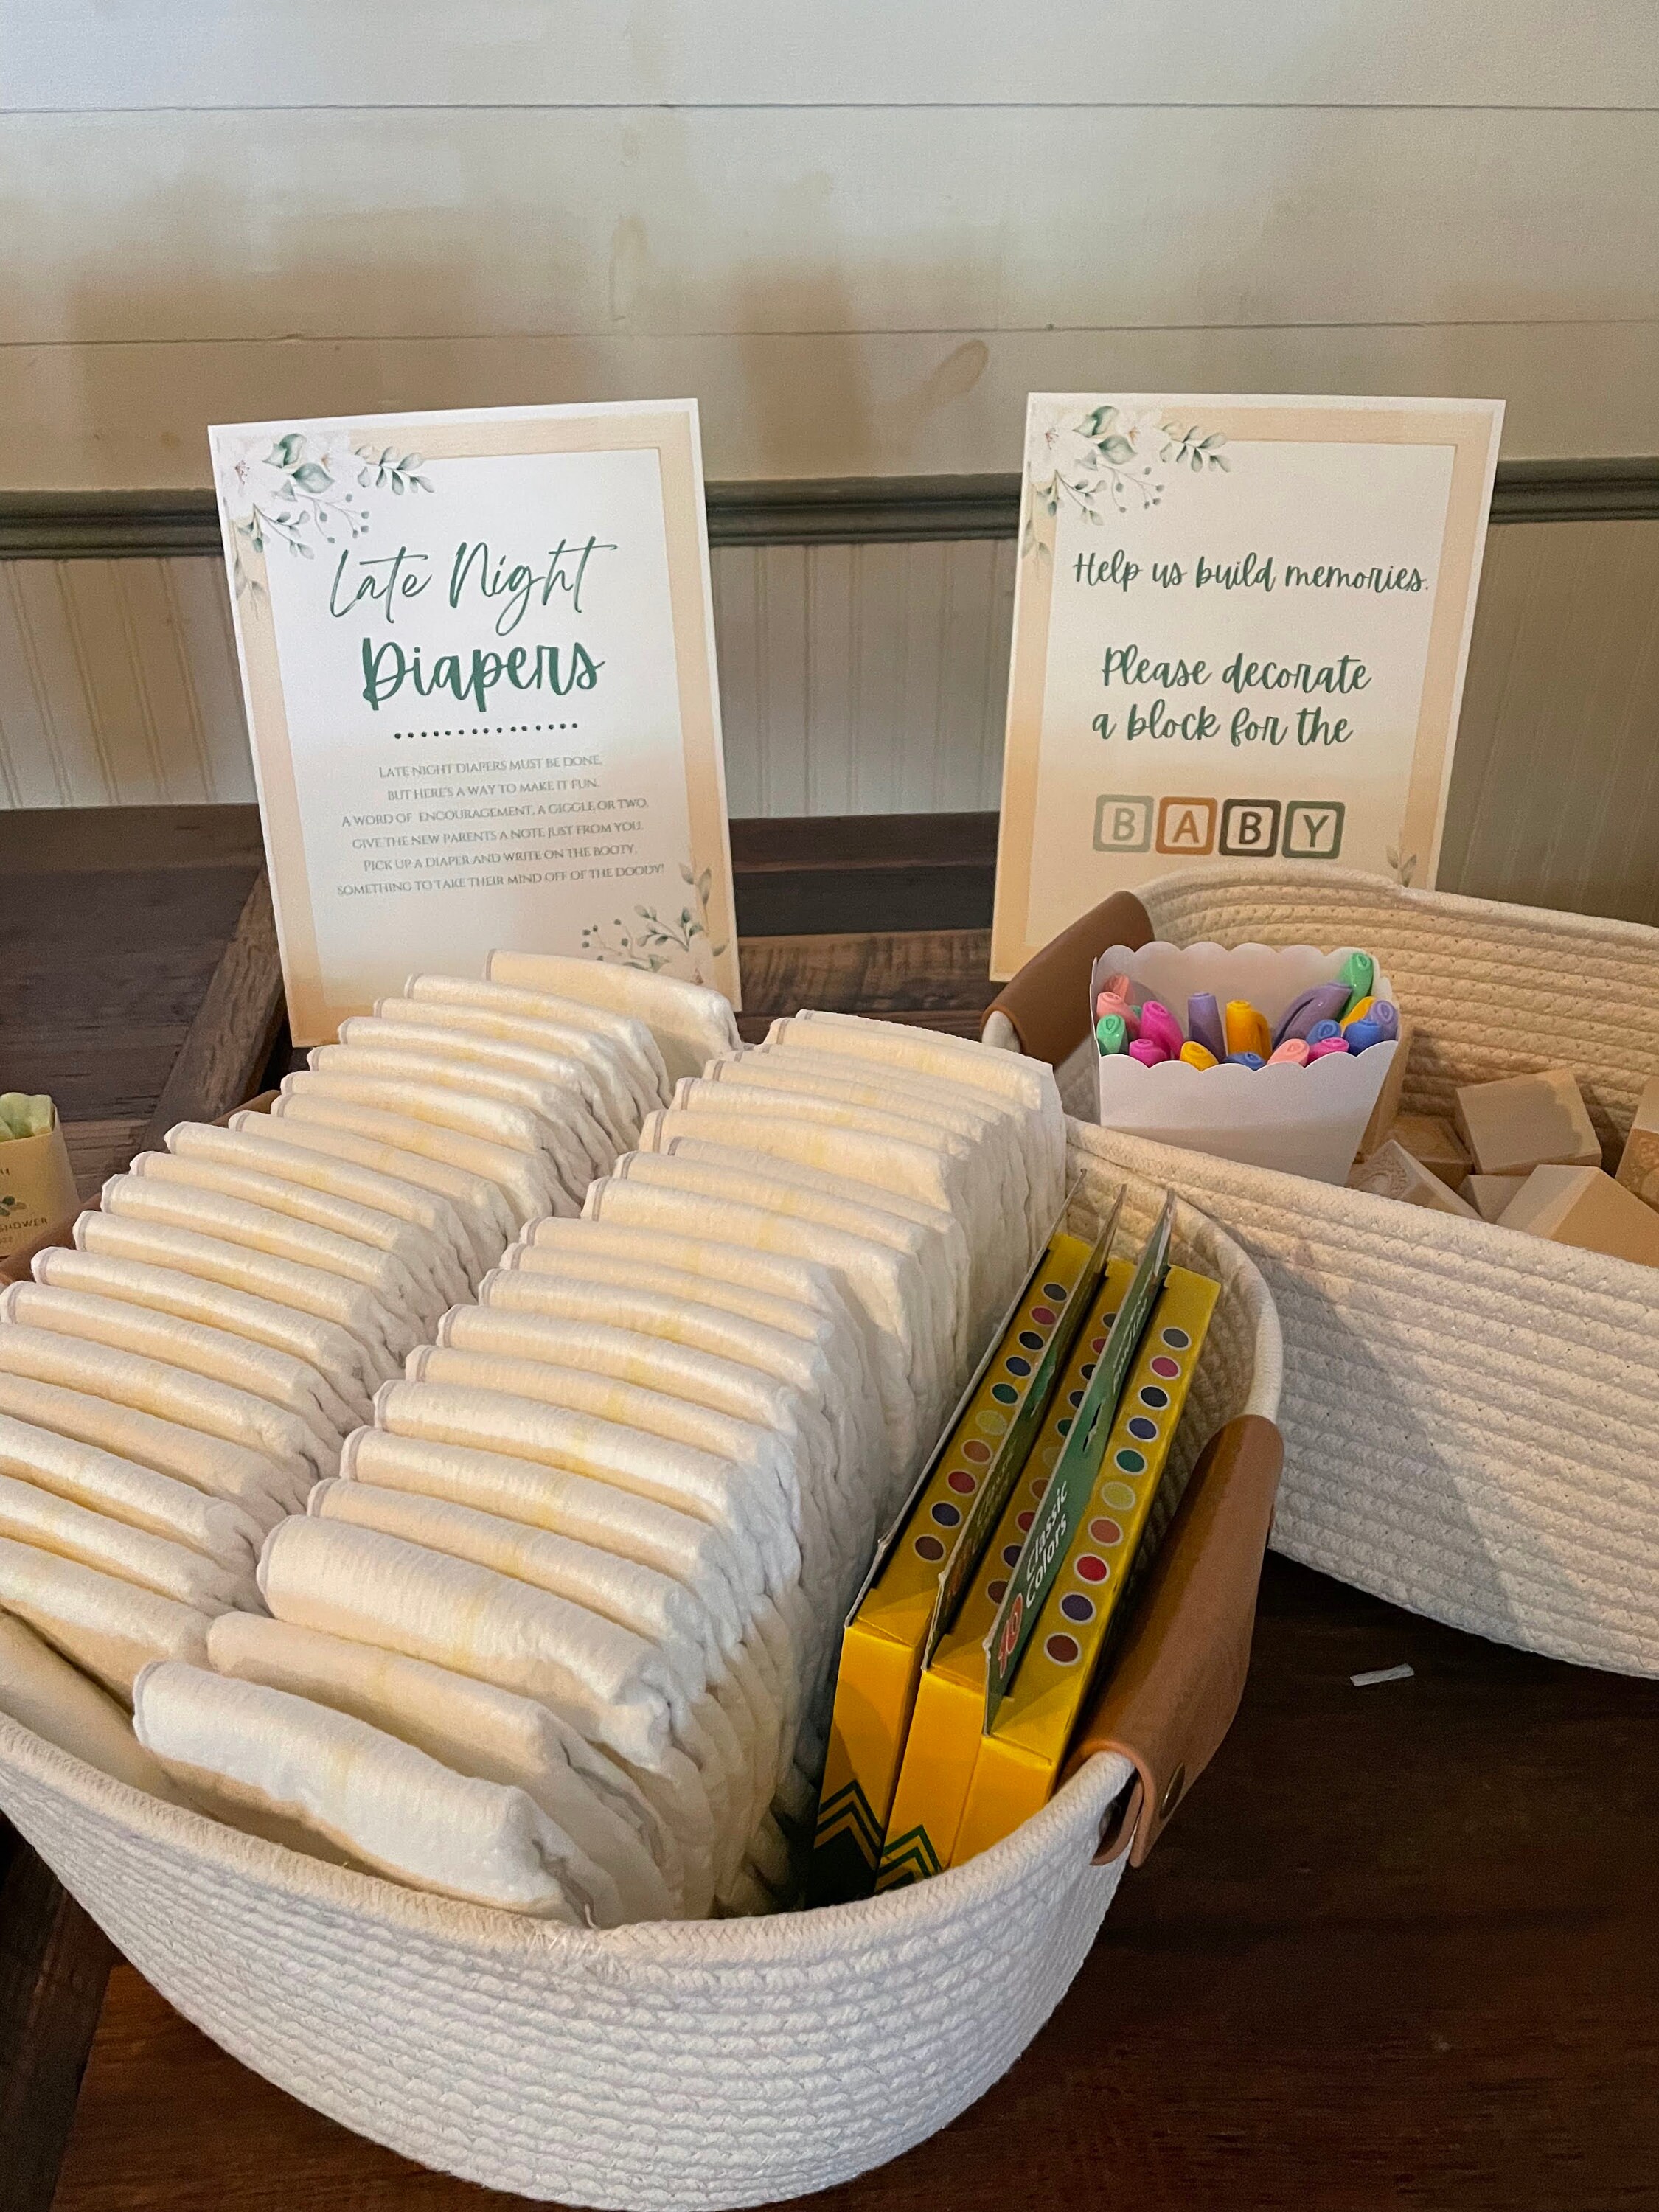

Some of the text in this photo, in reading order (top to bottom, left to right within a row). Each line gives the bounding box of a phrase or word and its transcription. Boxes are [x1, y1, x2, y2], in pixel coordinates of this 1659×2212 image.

[330, 536, 619, 636] Late Night
[1073, 549, 1430, 594] Help us build memories.
[361, 636, 606, 712] Diapers
[1101, 644, 1373, 694] Please decorate
[1092, 698, 1355, 748] a block for the
[378, 765, 411, 778] LATE
[411, 763, 452, 776] NIGHT
[456, 759, 507, 773] DIAPERS
[509, 757, 543, 771] MUST
[546, 757, 561, 768] BE
[387, 789, 411, 801] BUT
[456, 786, 465, 796] A
[467, 784, 496, 796] WAY
[499, 782, 517, 794] TO
[519, 779, 554, 793] MAKE
[556, 779, 568, 791] IT
[341, 815, 352, 827] A
[353, 813, 394, 826] WORD
[395, 812, 413, 824] OF
[537, 804, 546, 815] A
[597, 799, 616, 810] OR
[1110, 806, 1331, 849] BABY
[352, 837, 383, 849] GIVE
[383, 836, 411, 848] THE
[411, 833, 440, 846] NEW
[443, 830, 497, 844] PARENTS
[499, 830, 508, 841] A
[510, 827, 546, 839] NOTE
[547, 824, 574, 838] JUST
[576, 823, 612, 835] FROM
[364, 859, 393, 872] PICK
[395, 858, 412, 869] UP
[414, 858, 423, 869] A
[425, 855, 470, 868] DIAPER
[472, 852, 501, 864] AND
[504, 850, 542, 862] WRITE
[543, 848, 564, 860] ON
[566, 846, 591, 859] THE
[337, 880, 412, 896] SOMETHING
[414, 879, 432, 891] TO
[433, 877, 466, 890] TAKE
[466, 874, 504, 888] THEIR
[507, 872, 543, 885] MIND
[545, 870, 567, 882] OFF
[570, 869, 587, 881] OF
[589, 867, 613, 879] THE
[1026, 1480, 1068, 1582] Classic
[1026, 1513, 1067, 1609] Colors
